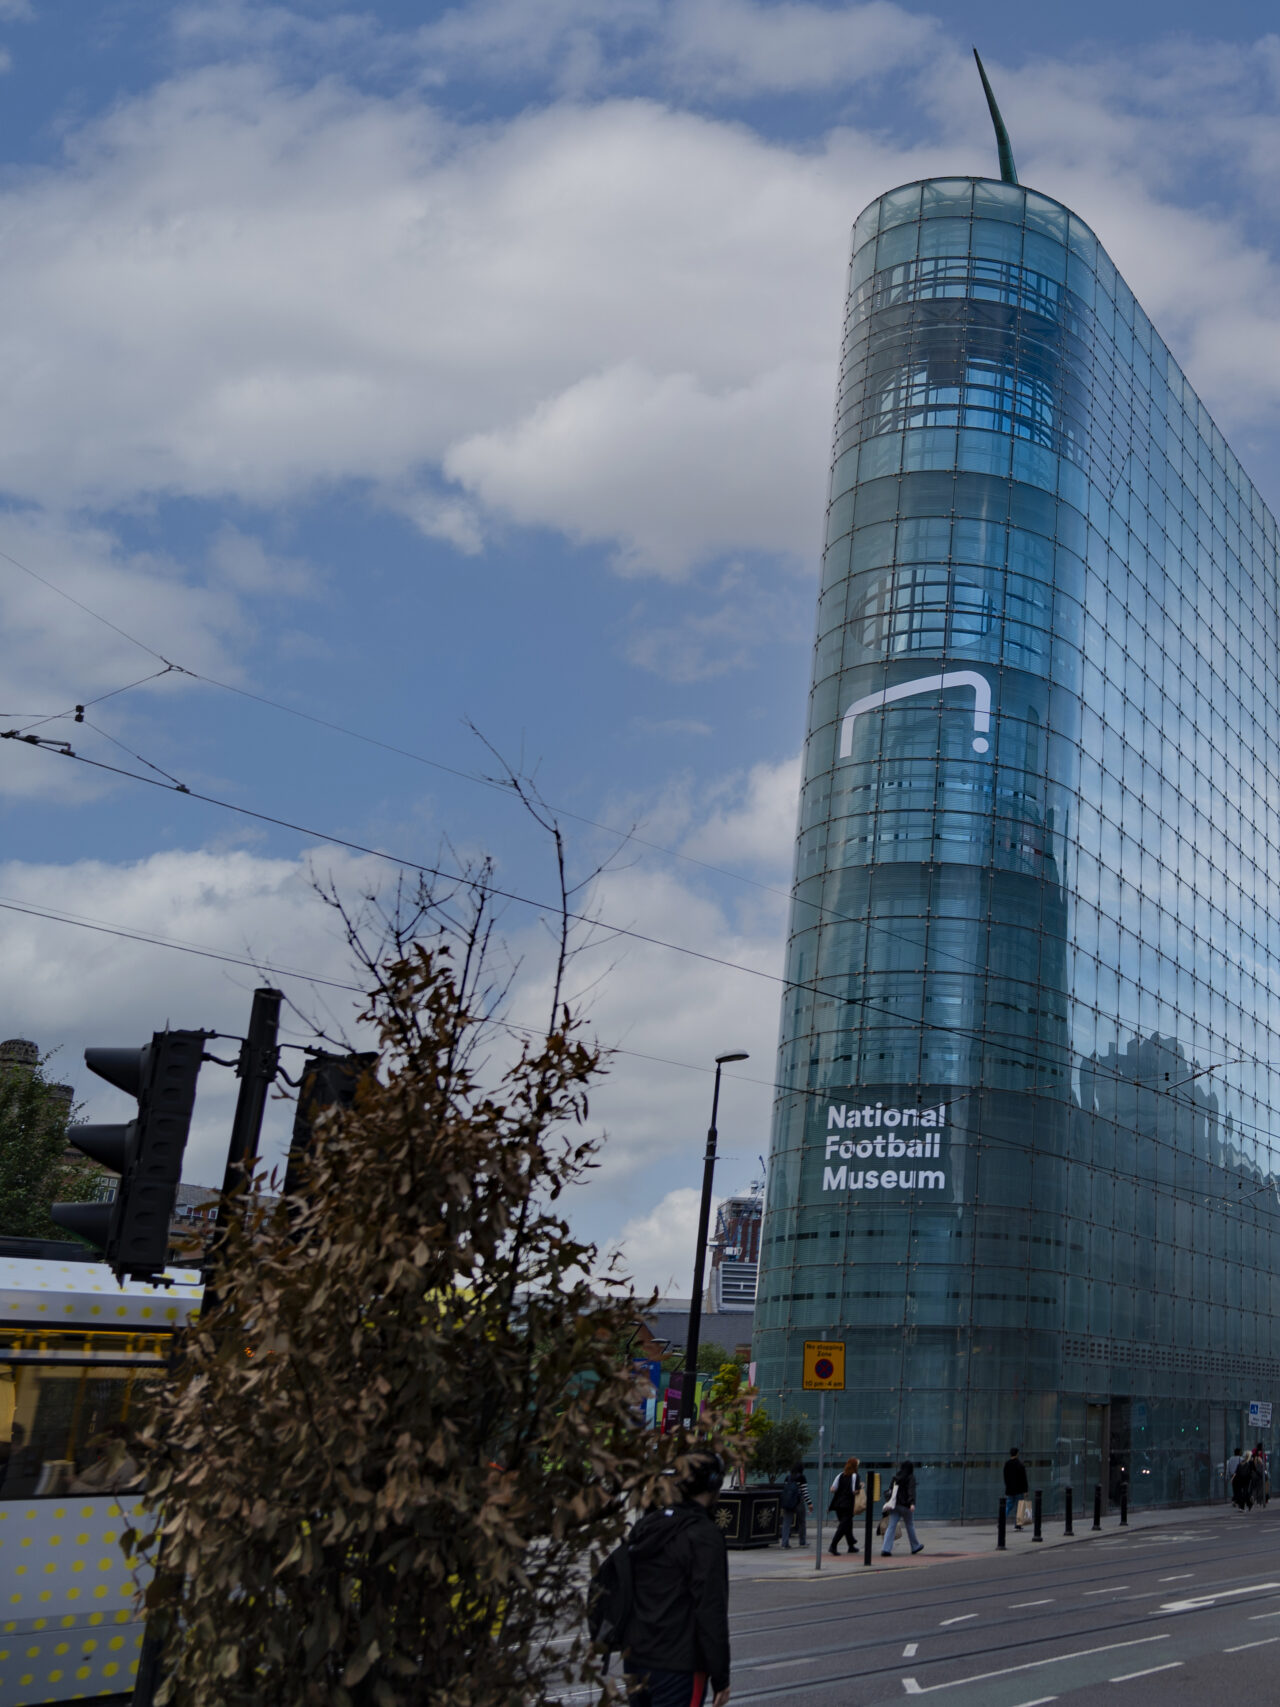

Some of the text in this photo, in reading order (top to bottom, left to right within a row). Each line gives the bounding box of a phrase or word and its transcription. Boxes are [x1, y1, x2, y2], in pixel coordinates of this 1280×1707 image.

[827, 1102, 946, 1129] National
[825, 1133, 941, 1160] Football
[822, 1166, 945, 1191] Museum
